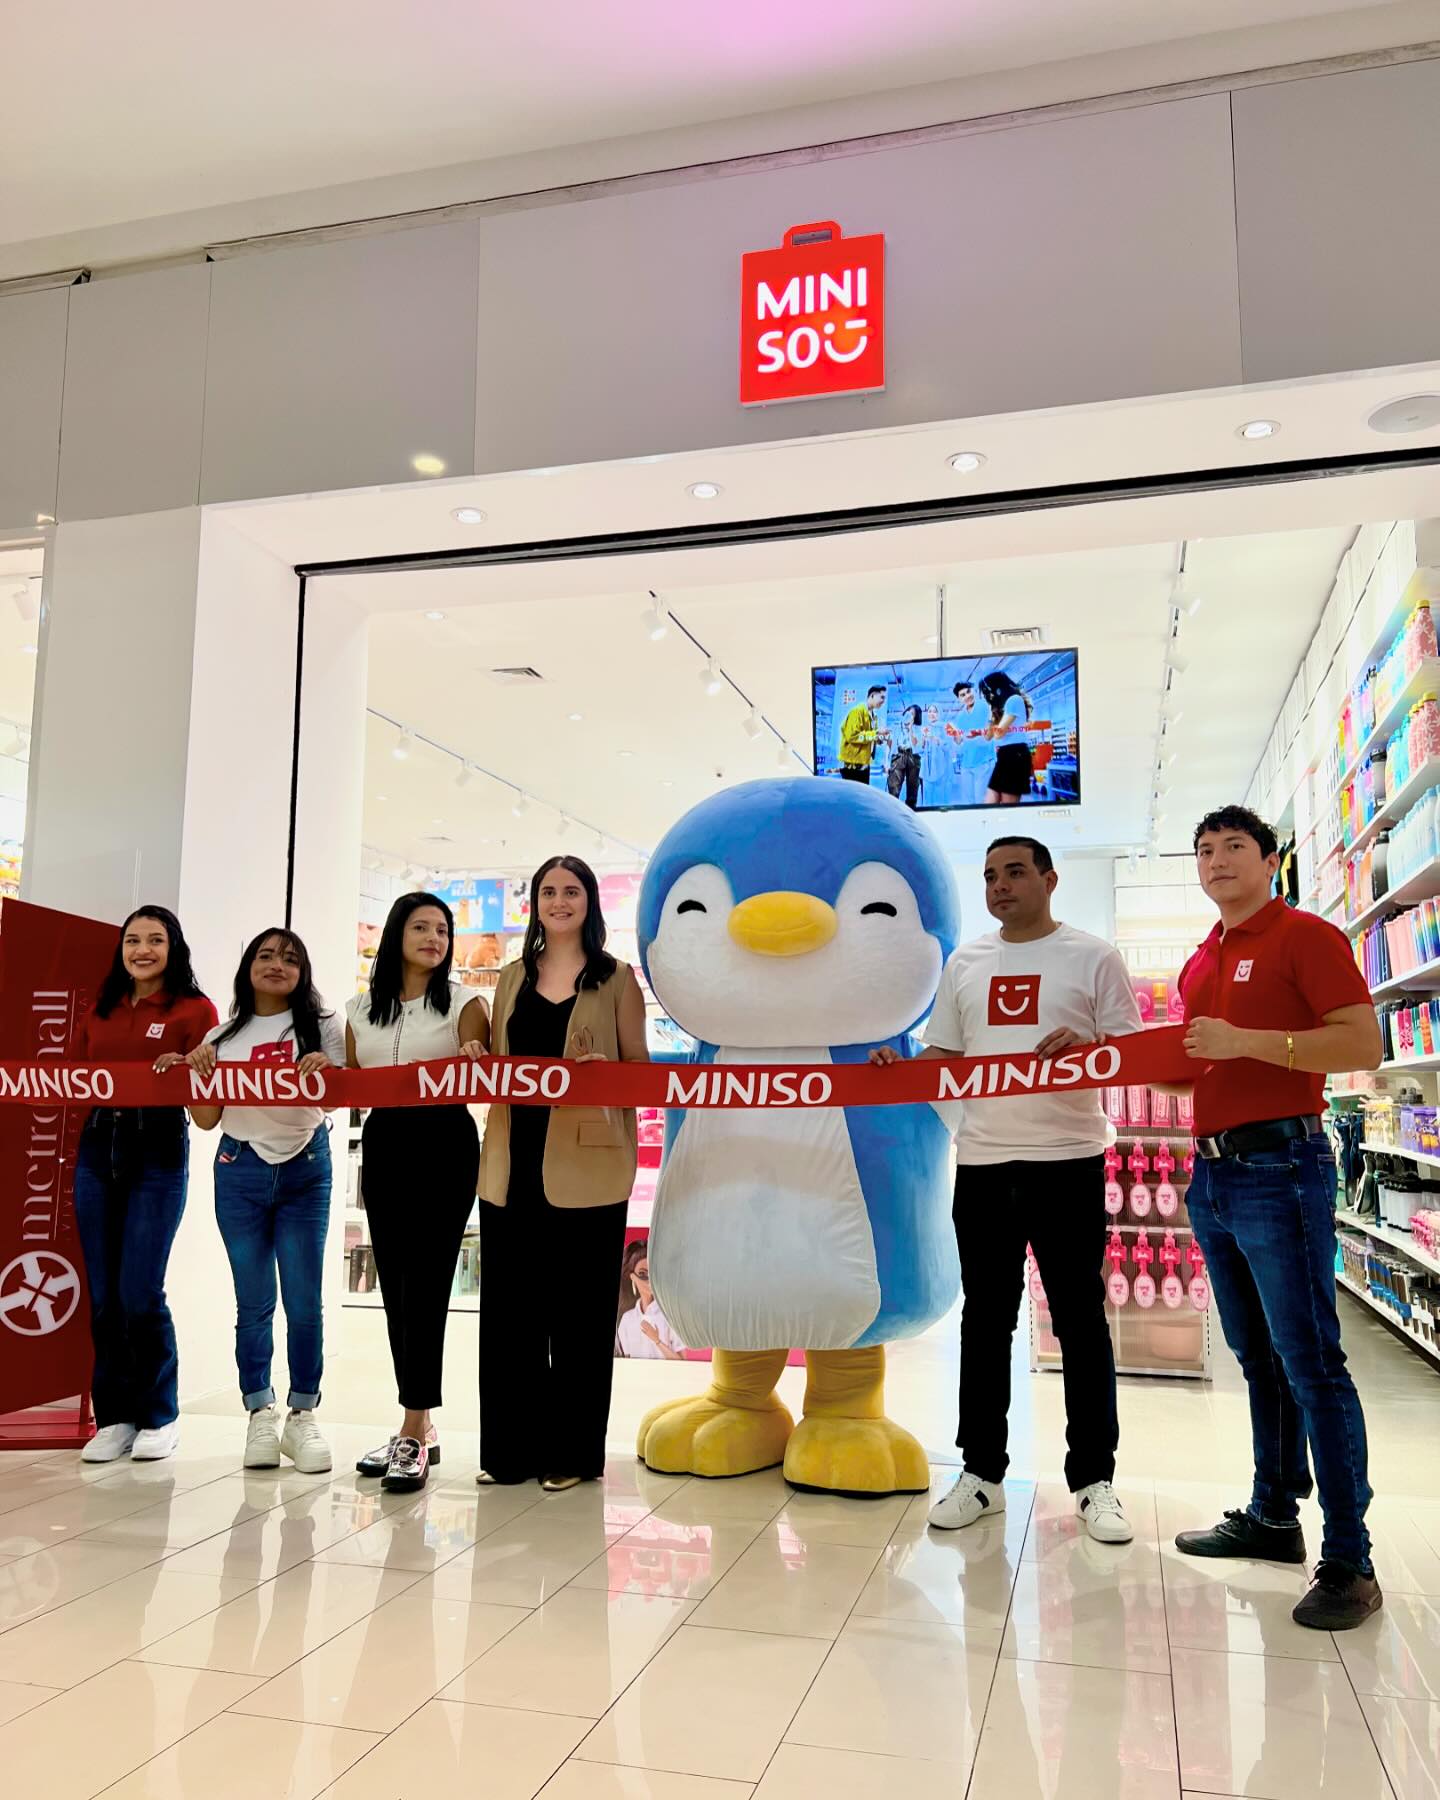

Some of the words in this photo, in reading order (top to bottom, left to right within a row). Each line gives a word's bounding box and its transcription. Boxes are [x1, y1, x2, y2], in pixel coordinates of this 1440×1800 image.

[757, 267, 867, 320] MINI
[0, 1067, 114, 1100] MINISO
[189, 1067, 326, 1101] MINISO
[417, 1062, 571, 1099] MINISO
[665, 1071, 832, 1105] MINISO
[937, 1045, 1122, 1100] MINISO
